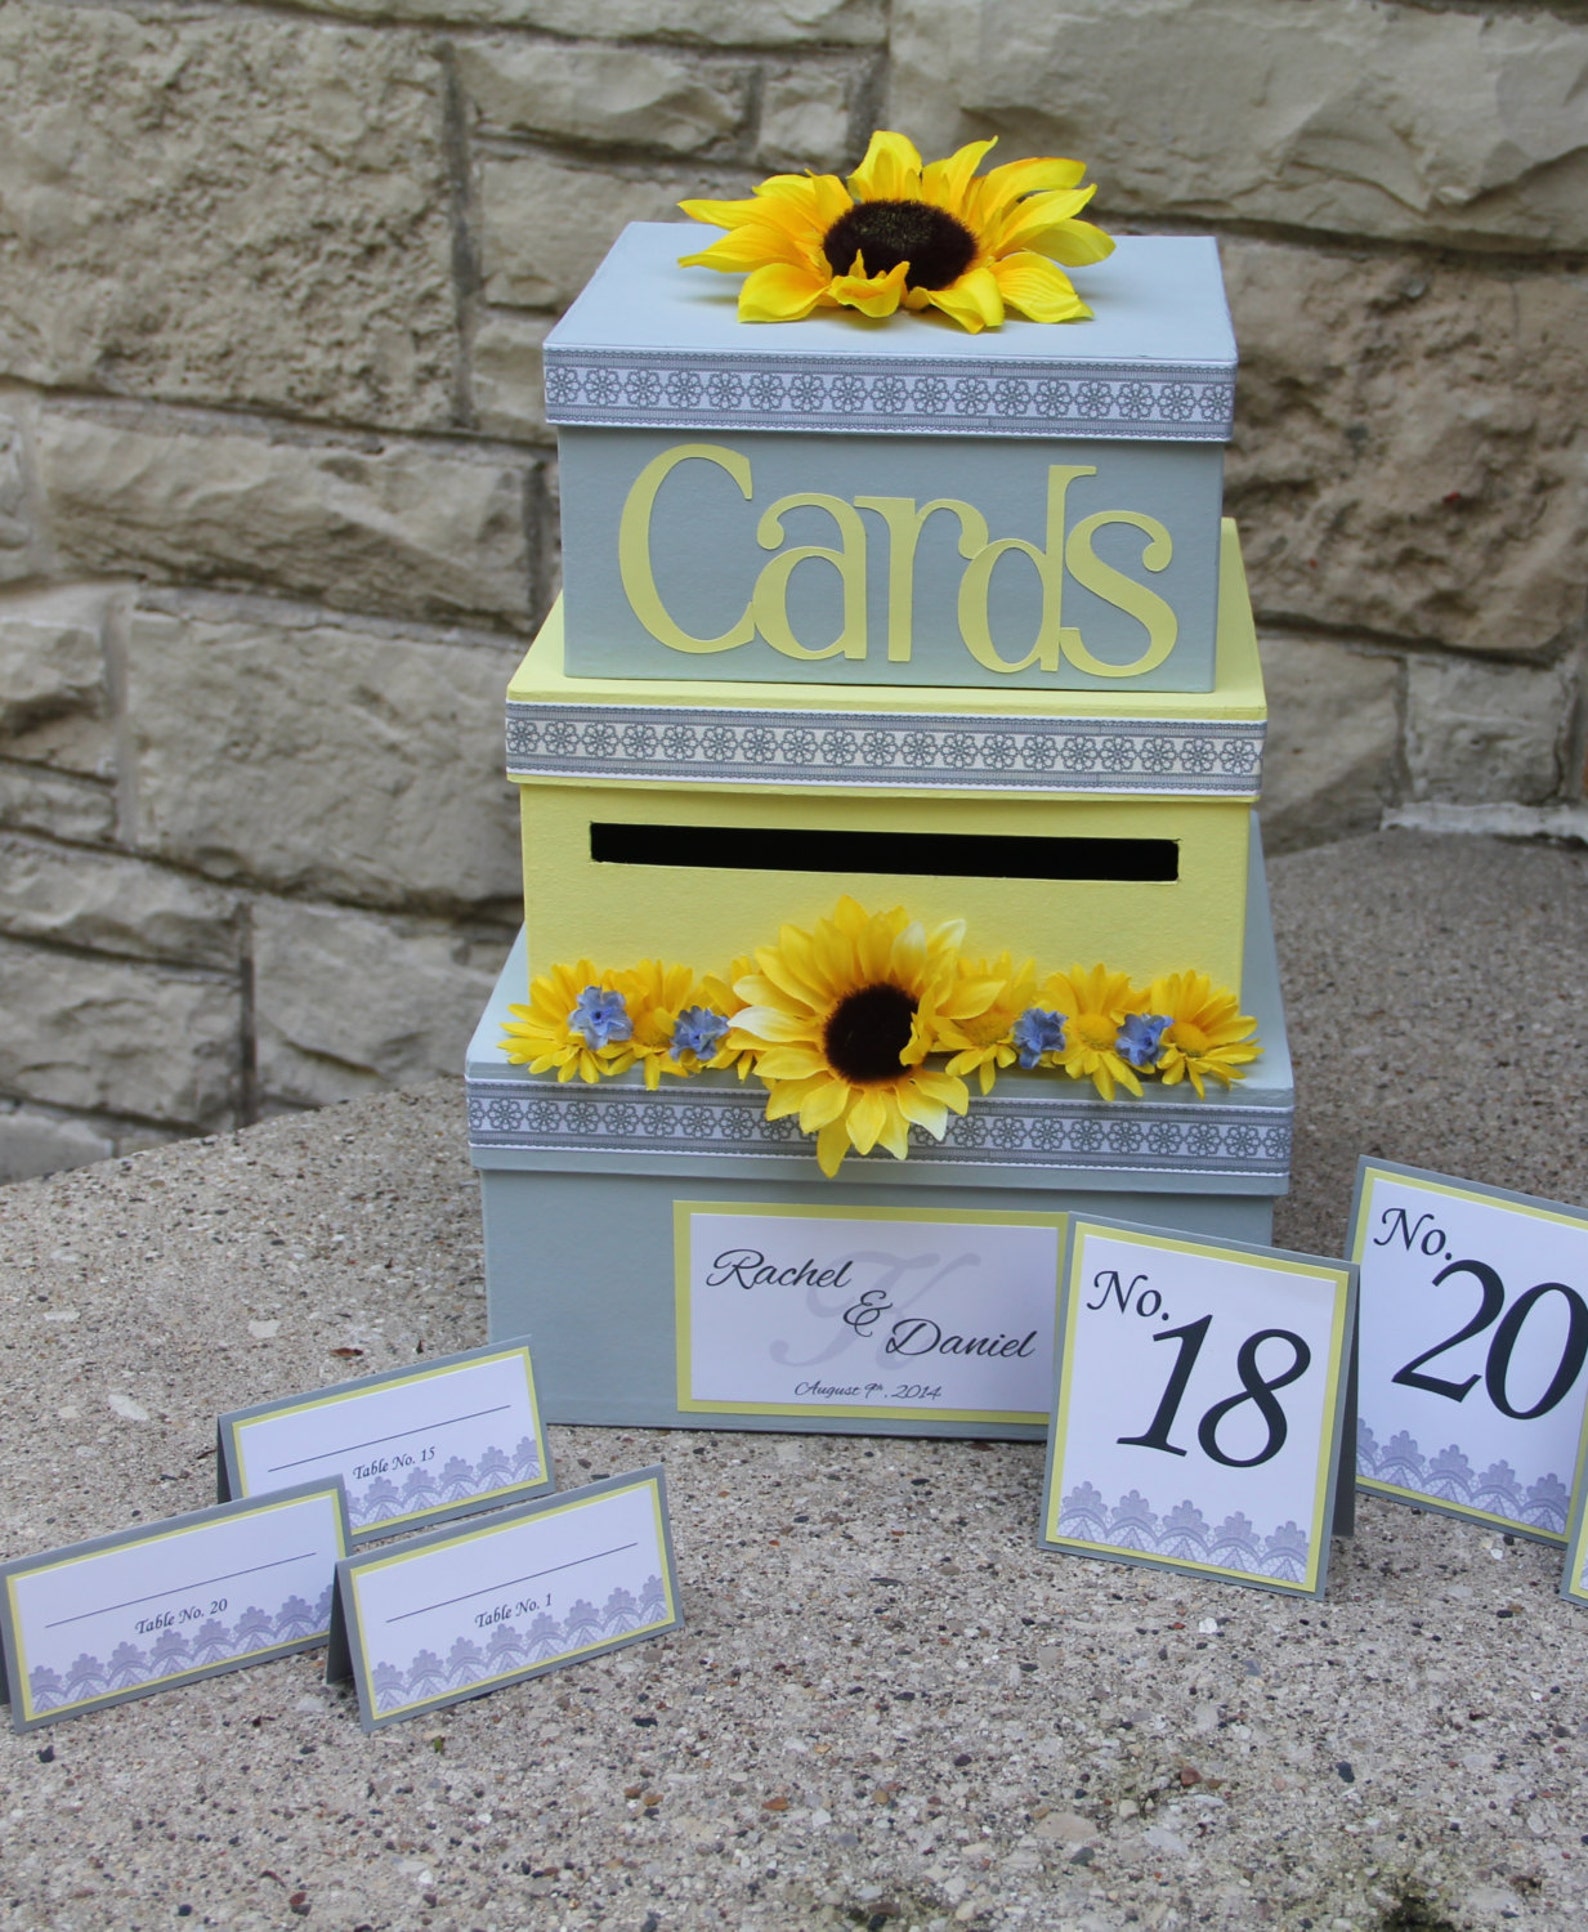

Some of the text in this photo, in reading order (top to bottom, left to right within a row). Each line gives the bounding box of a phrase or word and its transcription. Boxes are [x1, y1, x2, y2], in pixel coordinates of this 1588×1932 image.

[618, 443, 1179, 678] Cards
[1373, 1207, 1453, 1261] No.
[705, 1248, 853, 1290] Rachel
[843, 1289, 893, 1337] &
[1086, 1270, 1170, 1321] No.
[885, 1318, 1038, 1358] Daniel
[1391, 1258, 1588, 1420] 20
[794, 1380, 861, 1398] August
[891, 1384, 943, 1400] 2014
[1116, 1314, 1312, 1469] 18
[352, 1446, 436, 1480] Table No. 15
[134, 1598, 228, 1634] Table No. 20
[474, 1593, 552, 1628] Table No. 1
